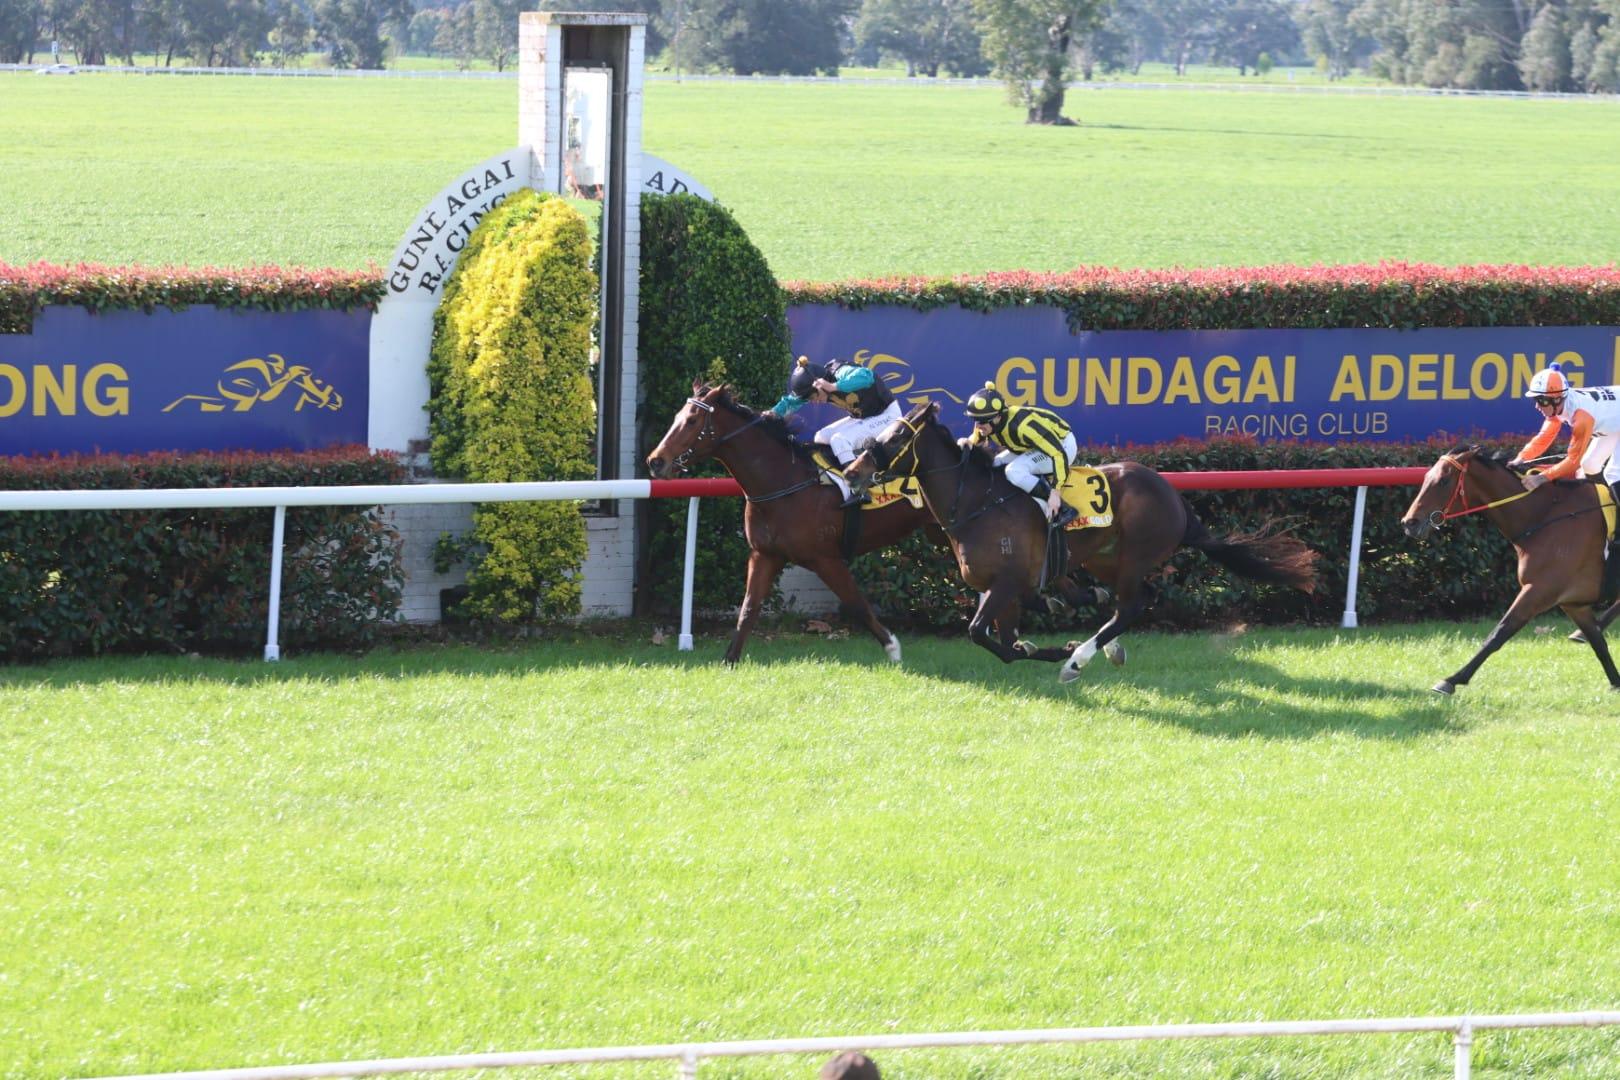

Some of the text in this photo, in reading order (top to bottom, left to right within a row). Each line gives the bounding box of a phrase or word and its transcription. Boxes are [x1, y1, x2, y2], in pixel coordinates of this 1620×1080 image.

[996, 355, 1295, 407] GUNDAGAI
[1205, 412, 1389, 437] RACING CLUB
[1087, 475, 1108, 514] 3
